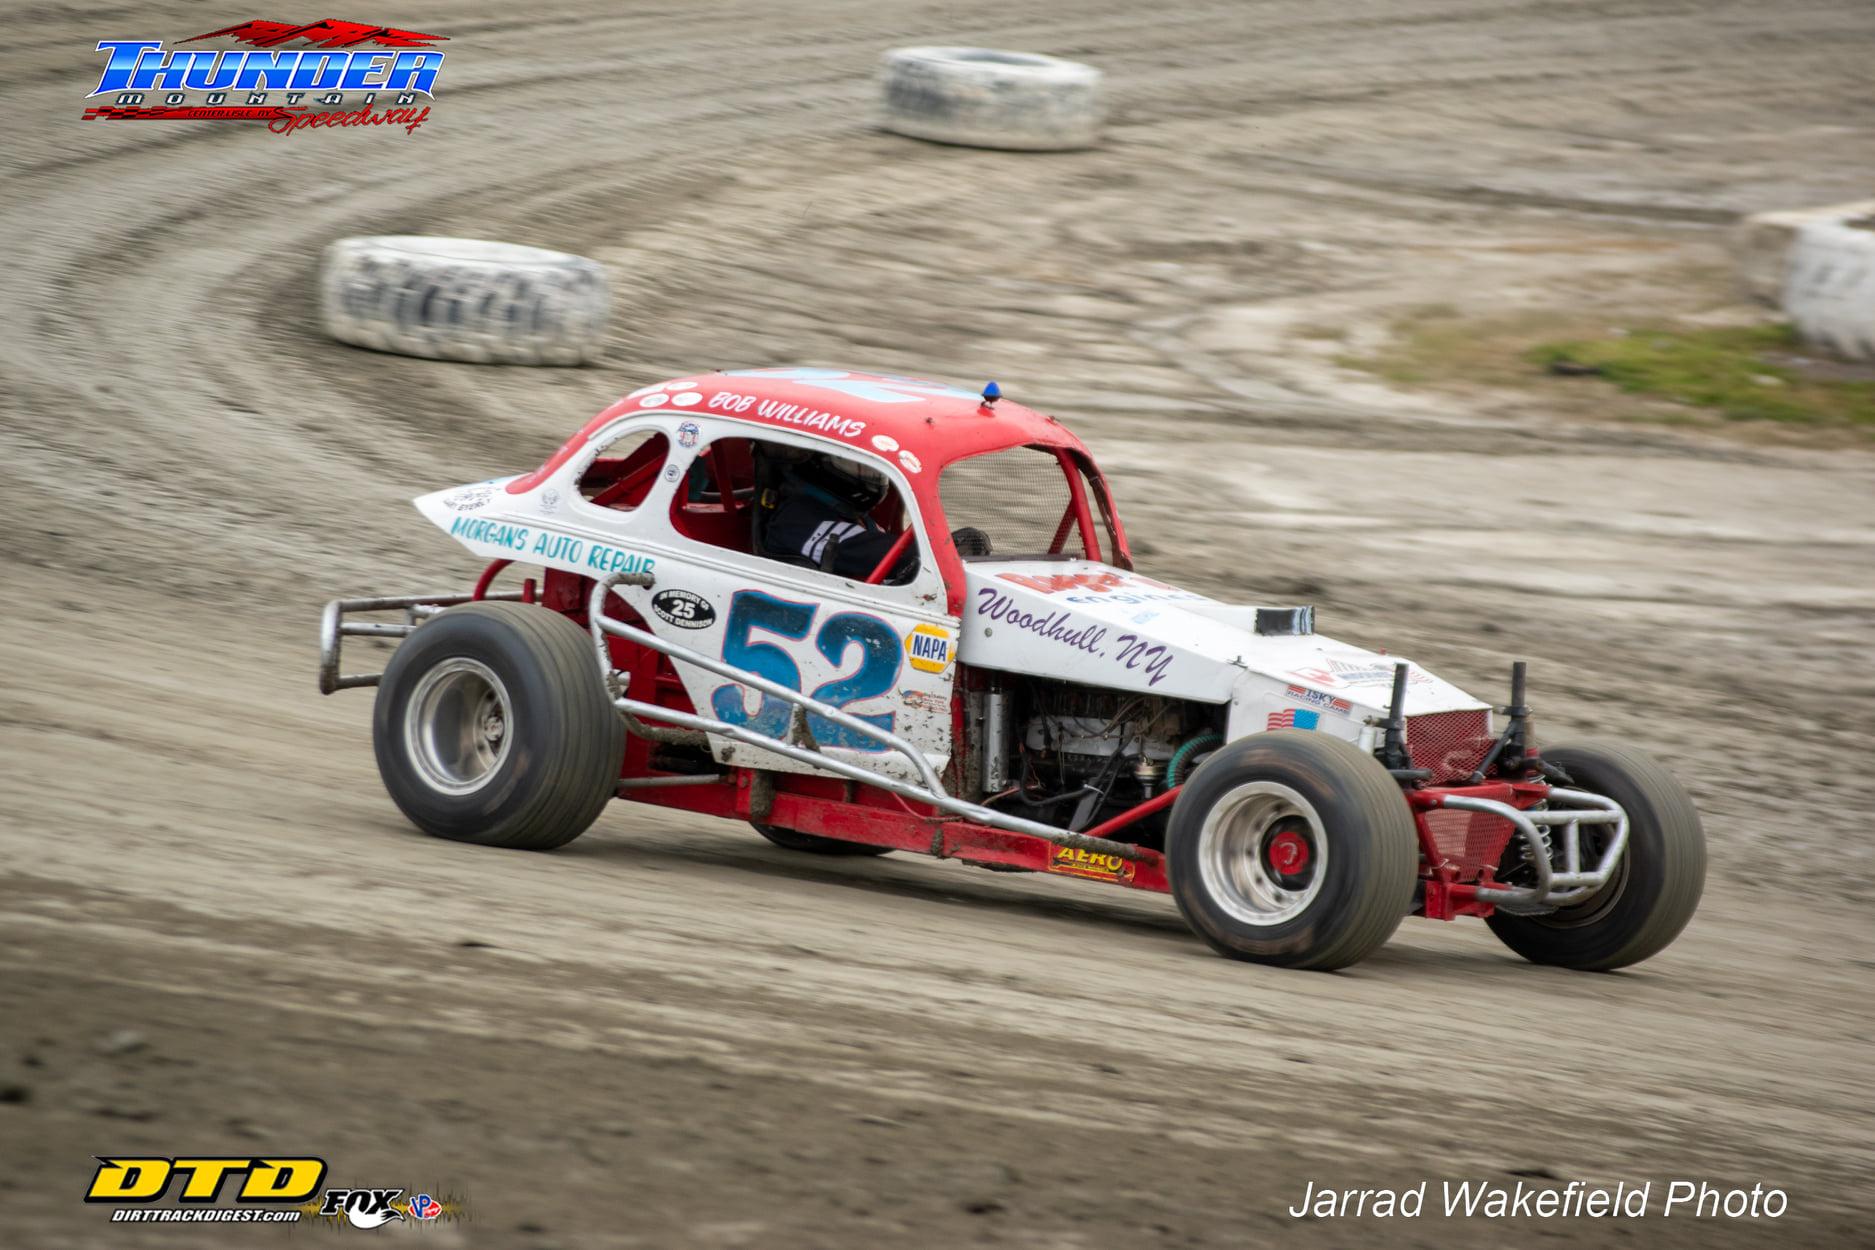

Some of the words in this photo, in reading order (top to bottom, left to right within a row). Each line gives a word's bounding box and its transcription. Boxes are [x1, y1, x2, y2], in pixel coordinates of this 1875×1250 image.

[708, 391, 756, 413] BOB
[757, 399, 866, 438] WILLIAMS
[533, 532, 583, 564] AUTO
[587, 545, 655, 574] REPAIR
[668, 590, 701, 604] MEMORY
[671, 599, 696, 619] 25
[654, 604, 675, 623] SCOTT
[912, 634, 947, 662] NAPA
[978, 588, 1106, 657] Woodhull,
[1116, 634, 1174, 687] NY
[711, 589, 904, 753] 52
[1307, 688, 1336, 704] ISKY
[1057, 847, 1122, 871] AERO
